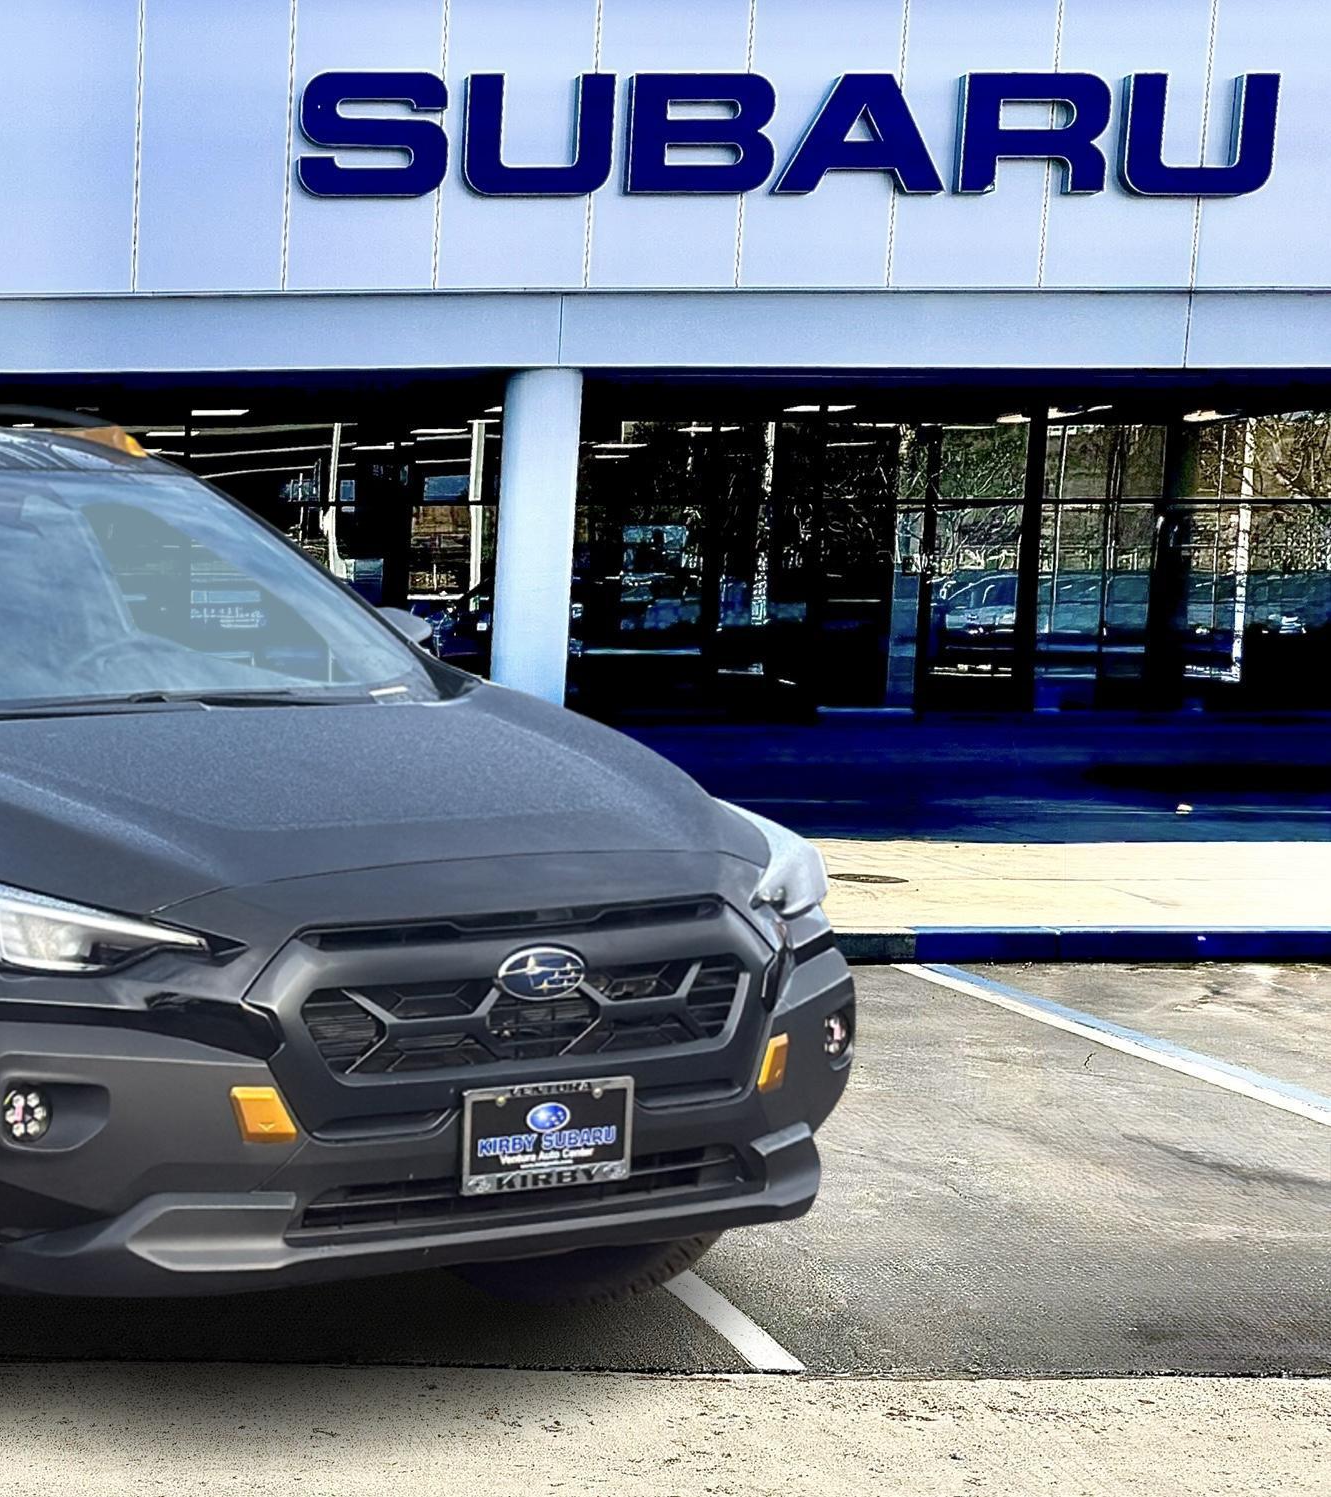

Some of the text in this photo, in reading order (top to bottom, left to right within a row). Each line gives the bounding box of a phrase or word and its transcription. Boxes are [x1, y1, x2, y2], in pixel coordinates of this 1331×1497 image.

[298, 71, 1281, 197] SUBARU
[510, 1081, 592, 1098] VENTURA
[478, 1125, 616, 1157] KIRBY SUBARU
[499, 1153, 537, 1165] Ventura
[538, 1149, 561, 1161] Auto
[562, 1147, 595, 1159] Center
[495, 1165, 600, 1190] KIRBY
